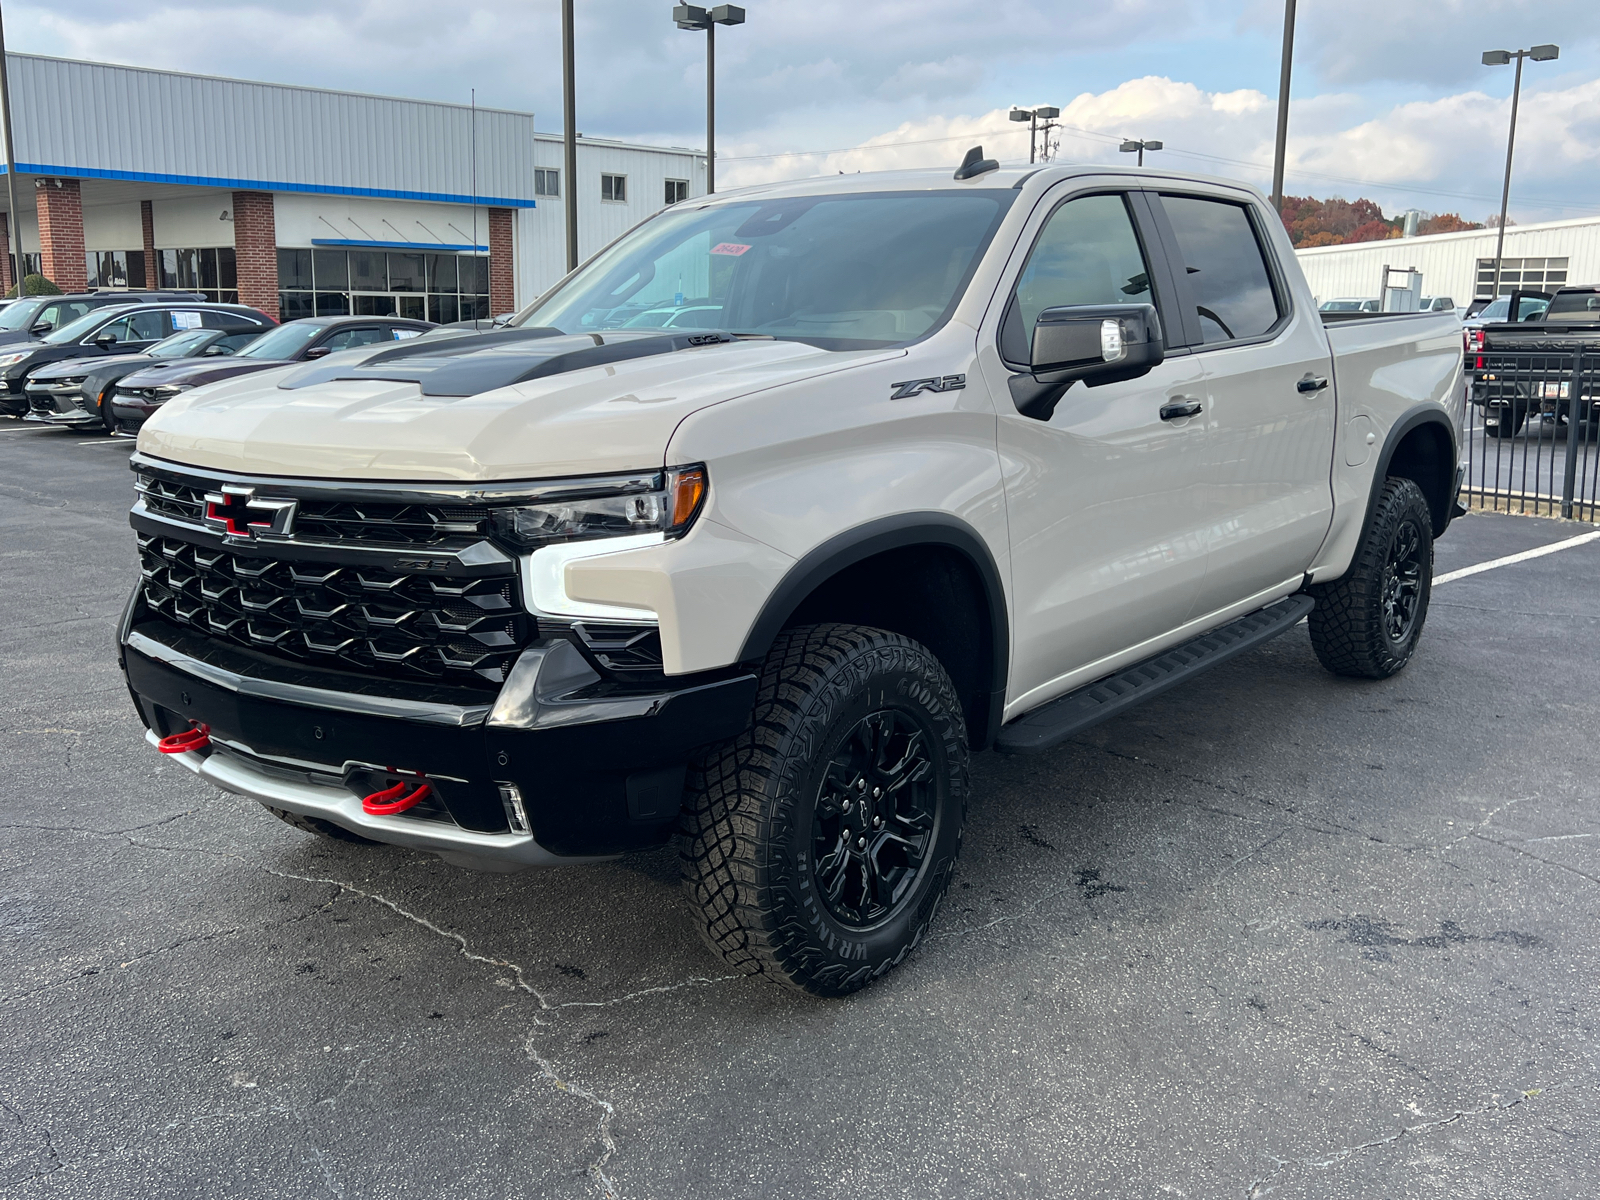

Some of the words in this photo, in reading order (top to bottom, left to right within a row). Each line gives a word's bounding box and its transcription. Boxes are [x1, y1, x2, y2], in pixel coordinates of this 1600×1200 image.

[890, 373, 966, 400] ZR2
[896, 677, 961, 797] GOODYEAR
[796, 850, 868, 961] WRANGLER
